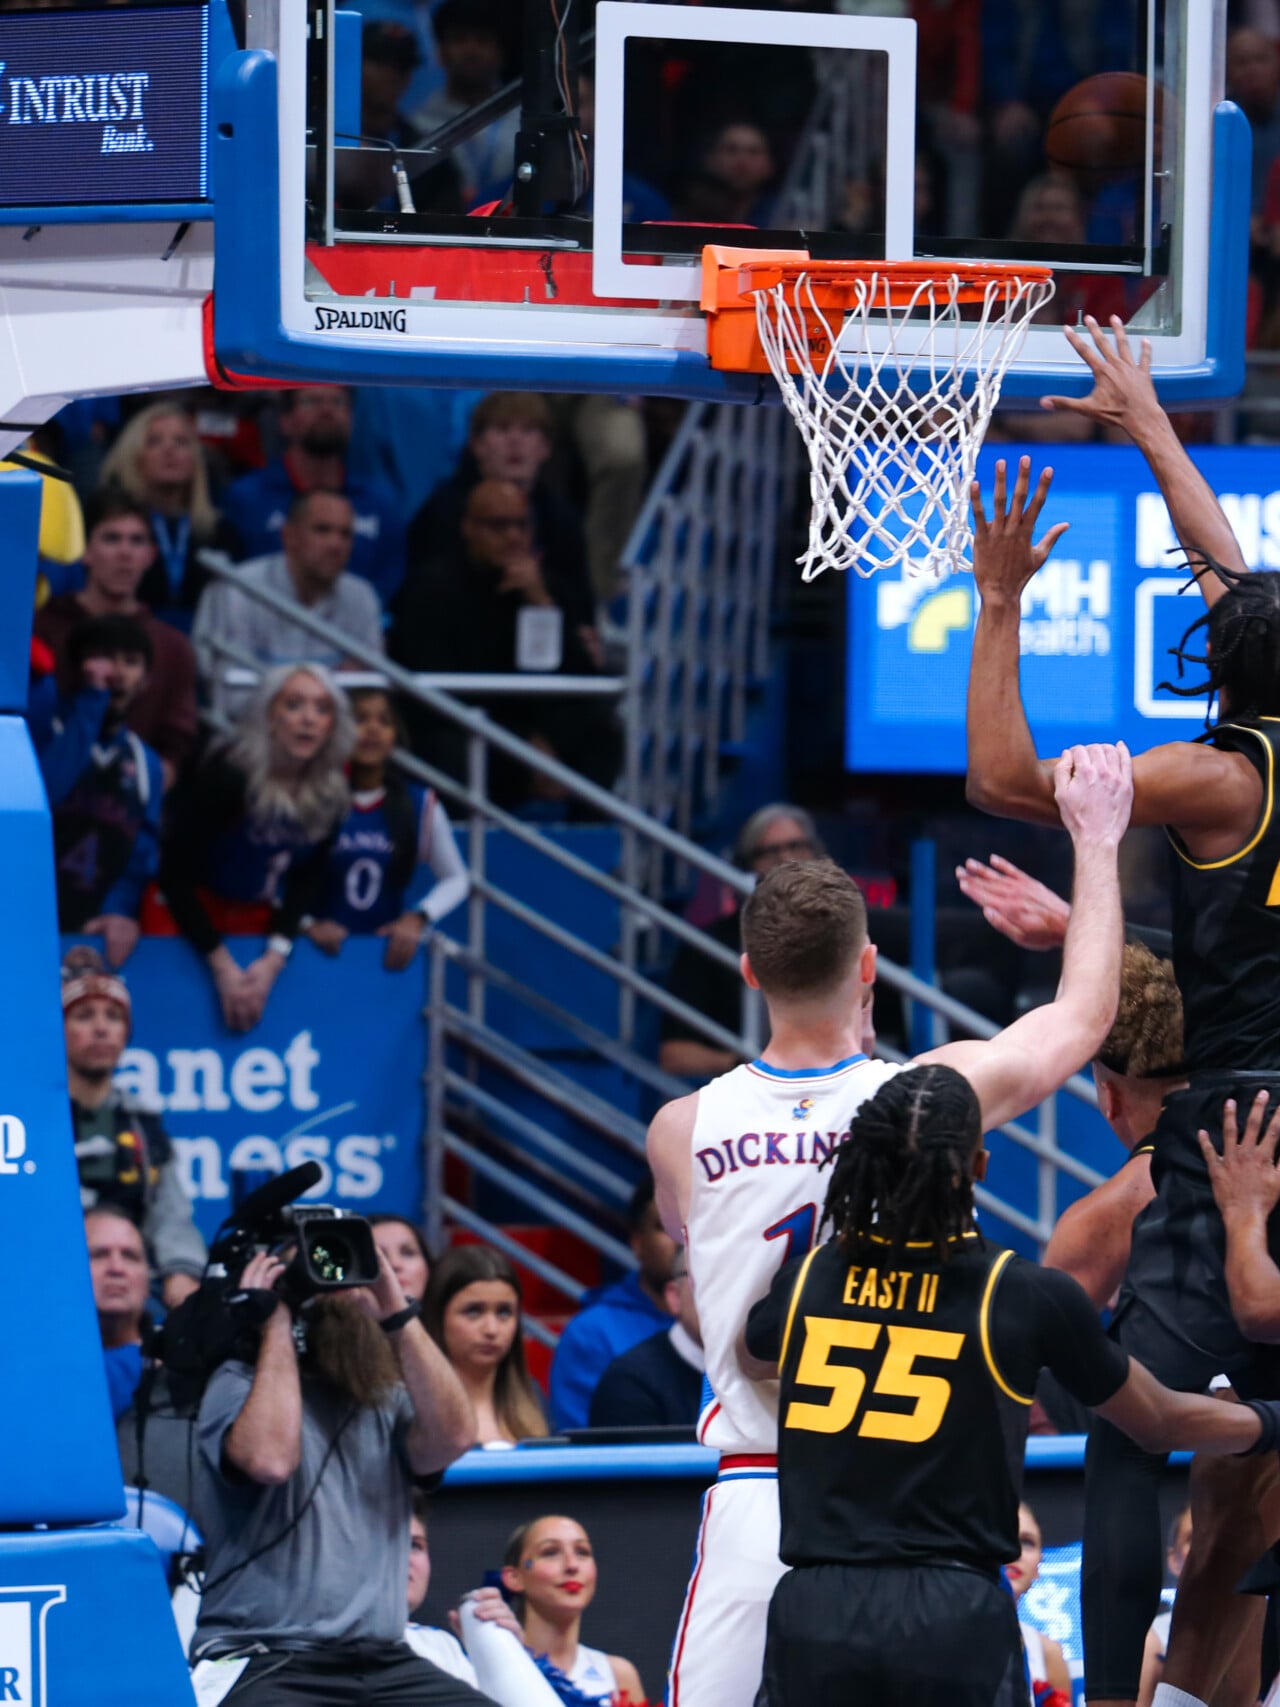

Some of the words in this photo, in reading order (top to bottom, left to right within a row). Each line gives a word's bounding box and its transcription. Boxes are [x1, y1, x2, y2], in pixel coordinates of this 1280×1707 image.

[8, 73, 149, 124] INTRUST
[314, 306, 406, 333] SPALDING
[1018, 559, 1110, 618] MH
[346, 858, 383, 910] 0
[113, 1030, 321, 1112] anet
[695, 1131, 853, 1182] DICKIN
[842, 1265, 914, 1311] EAST
[917, 1272, 940, 1313] II
[784, 1315, 967, 1444] 55
